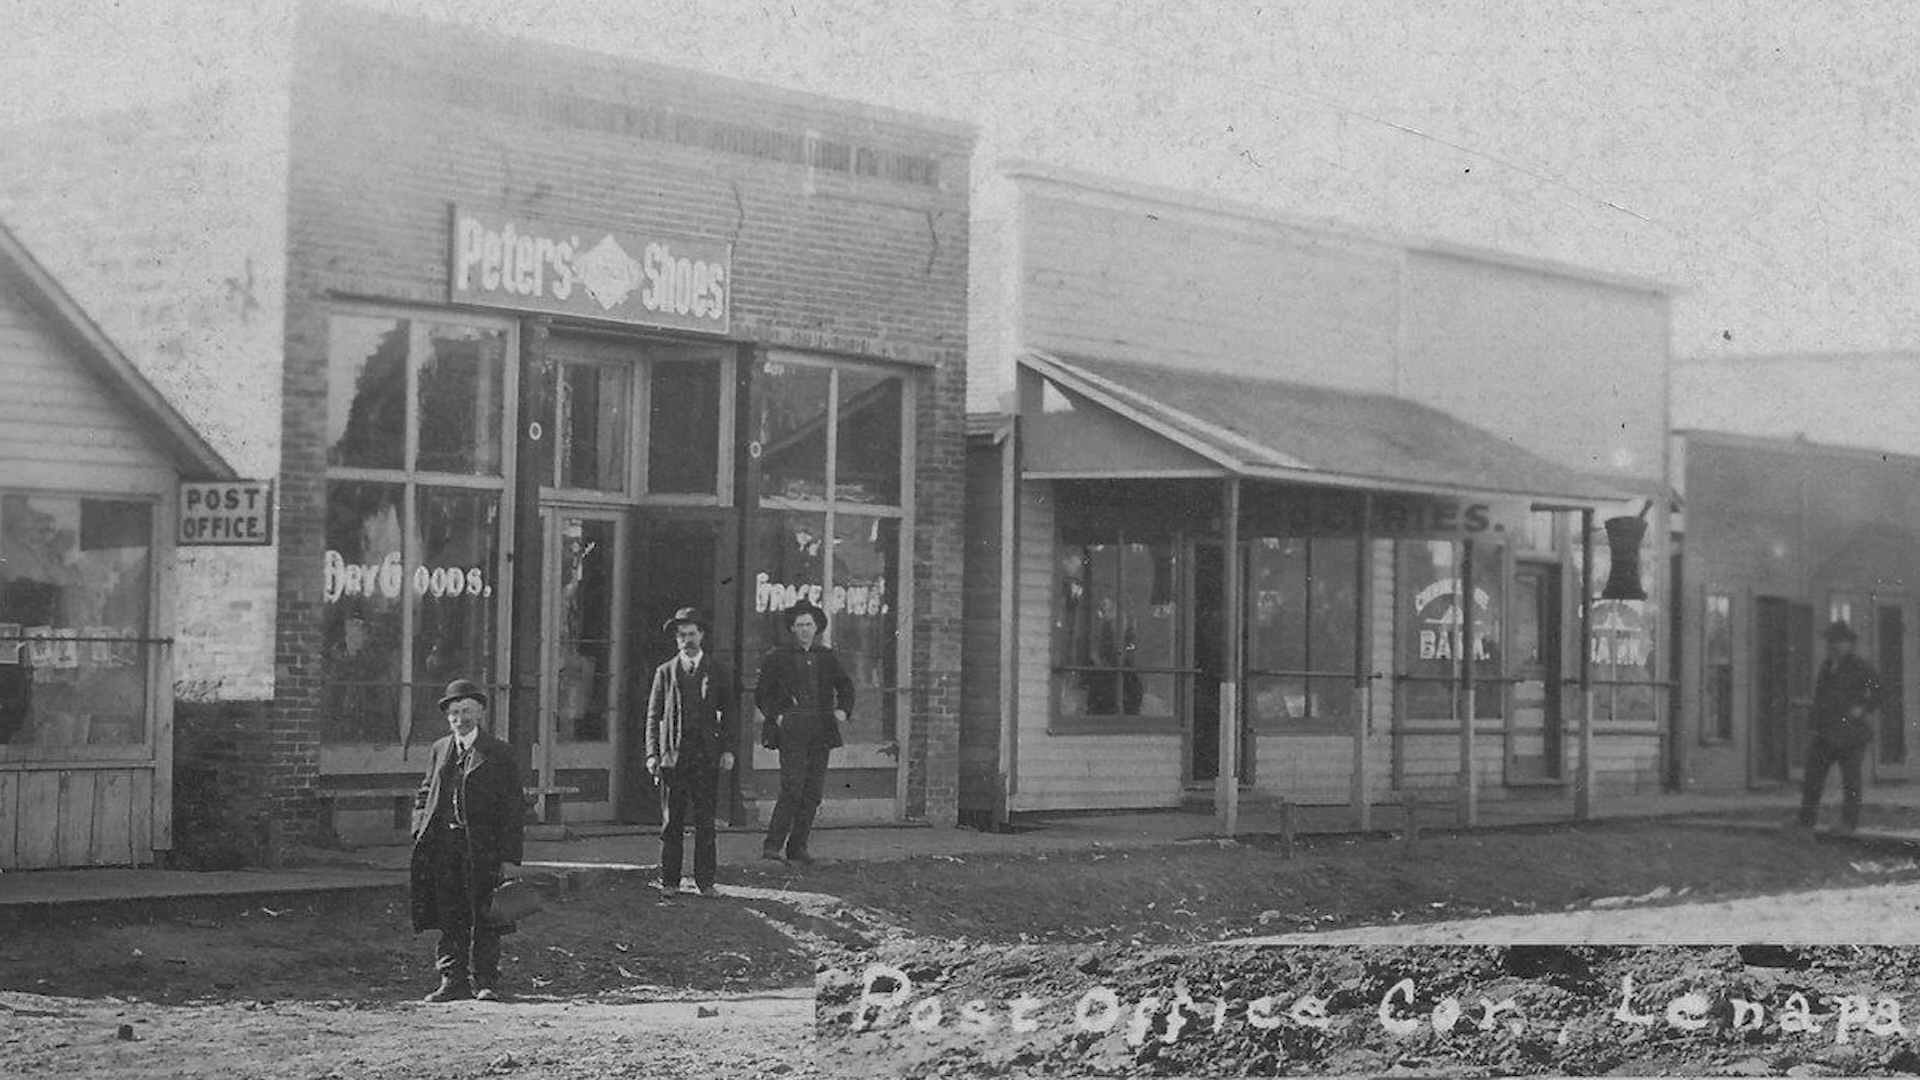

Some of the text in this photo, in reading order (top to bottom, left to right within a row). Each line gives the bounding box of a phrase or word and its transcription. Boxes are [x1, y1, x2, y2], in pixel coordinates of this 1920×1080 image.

[458, 217, 725, 320] Peters' Shoes
[187, 488, 260, 511] POST
